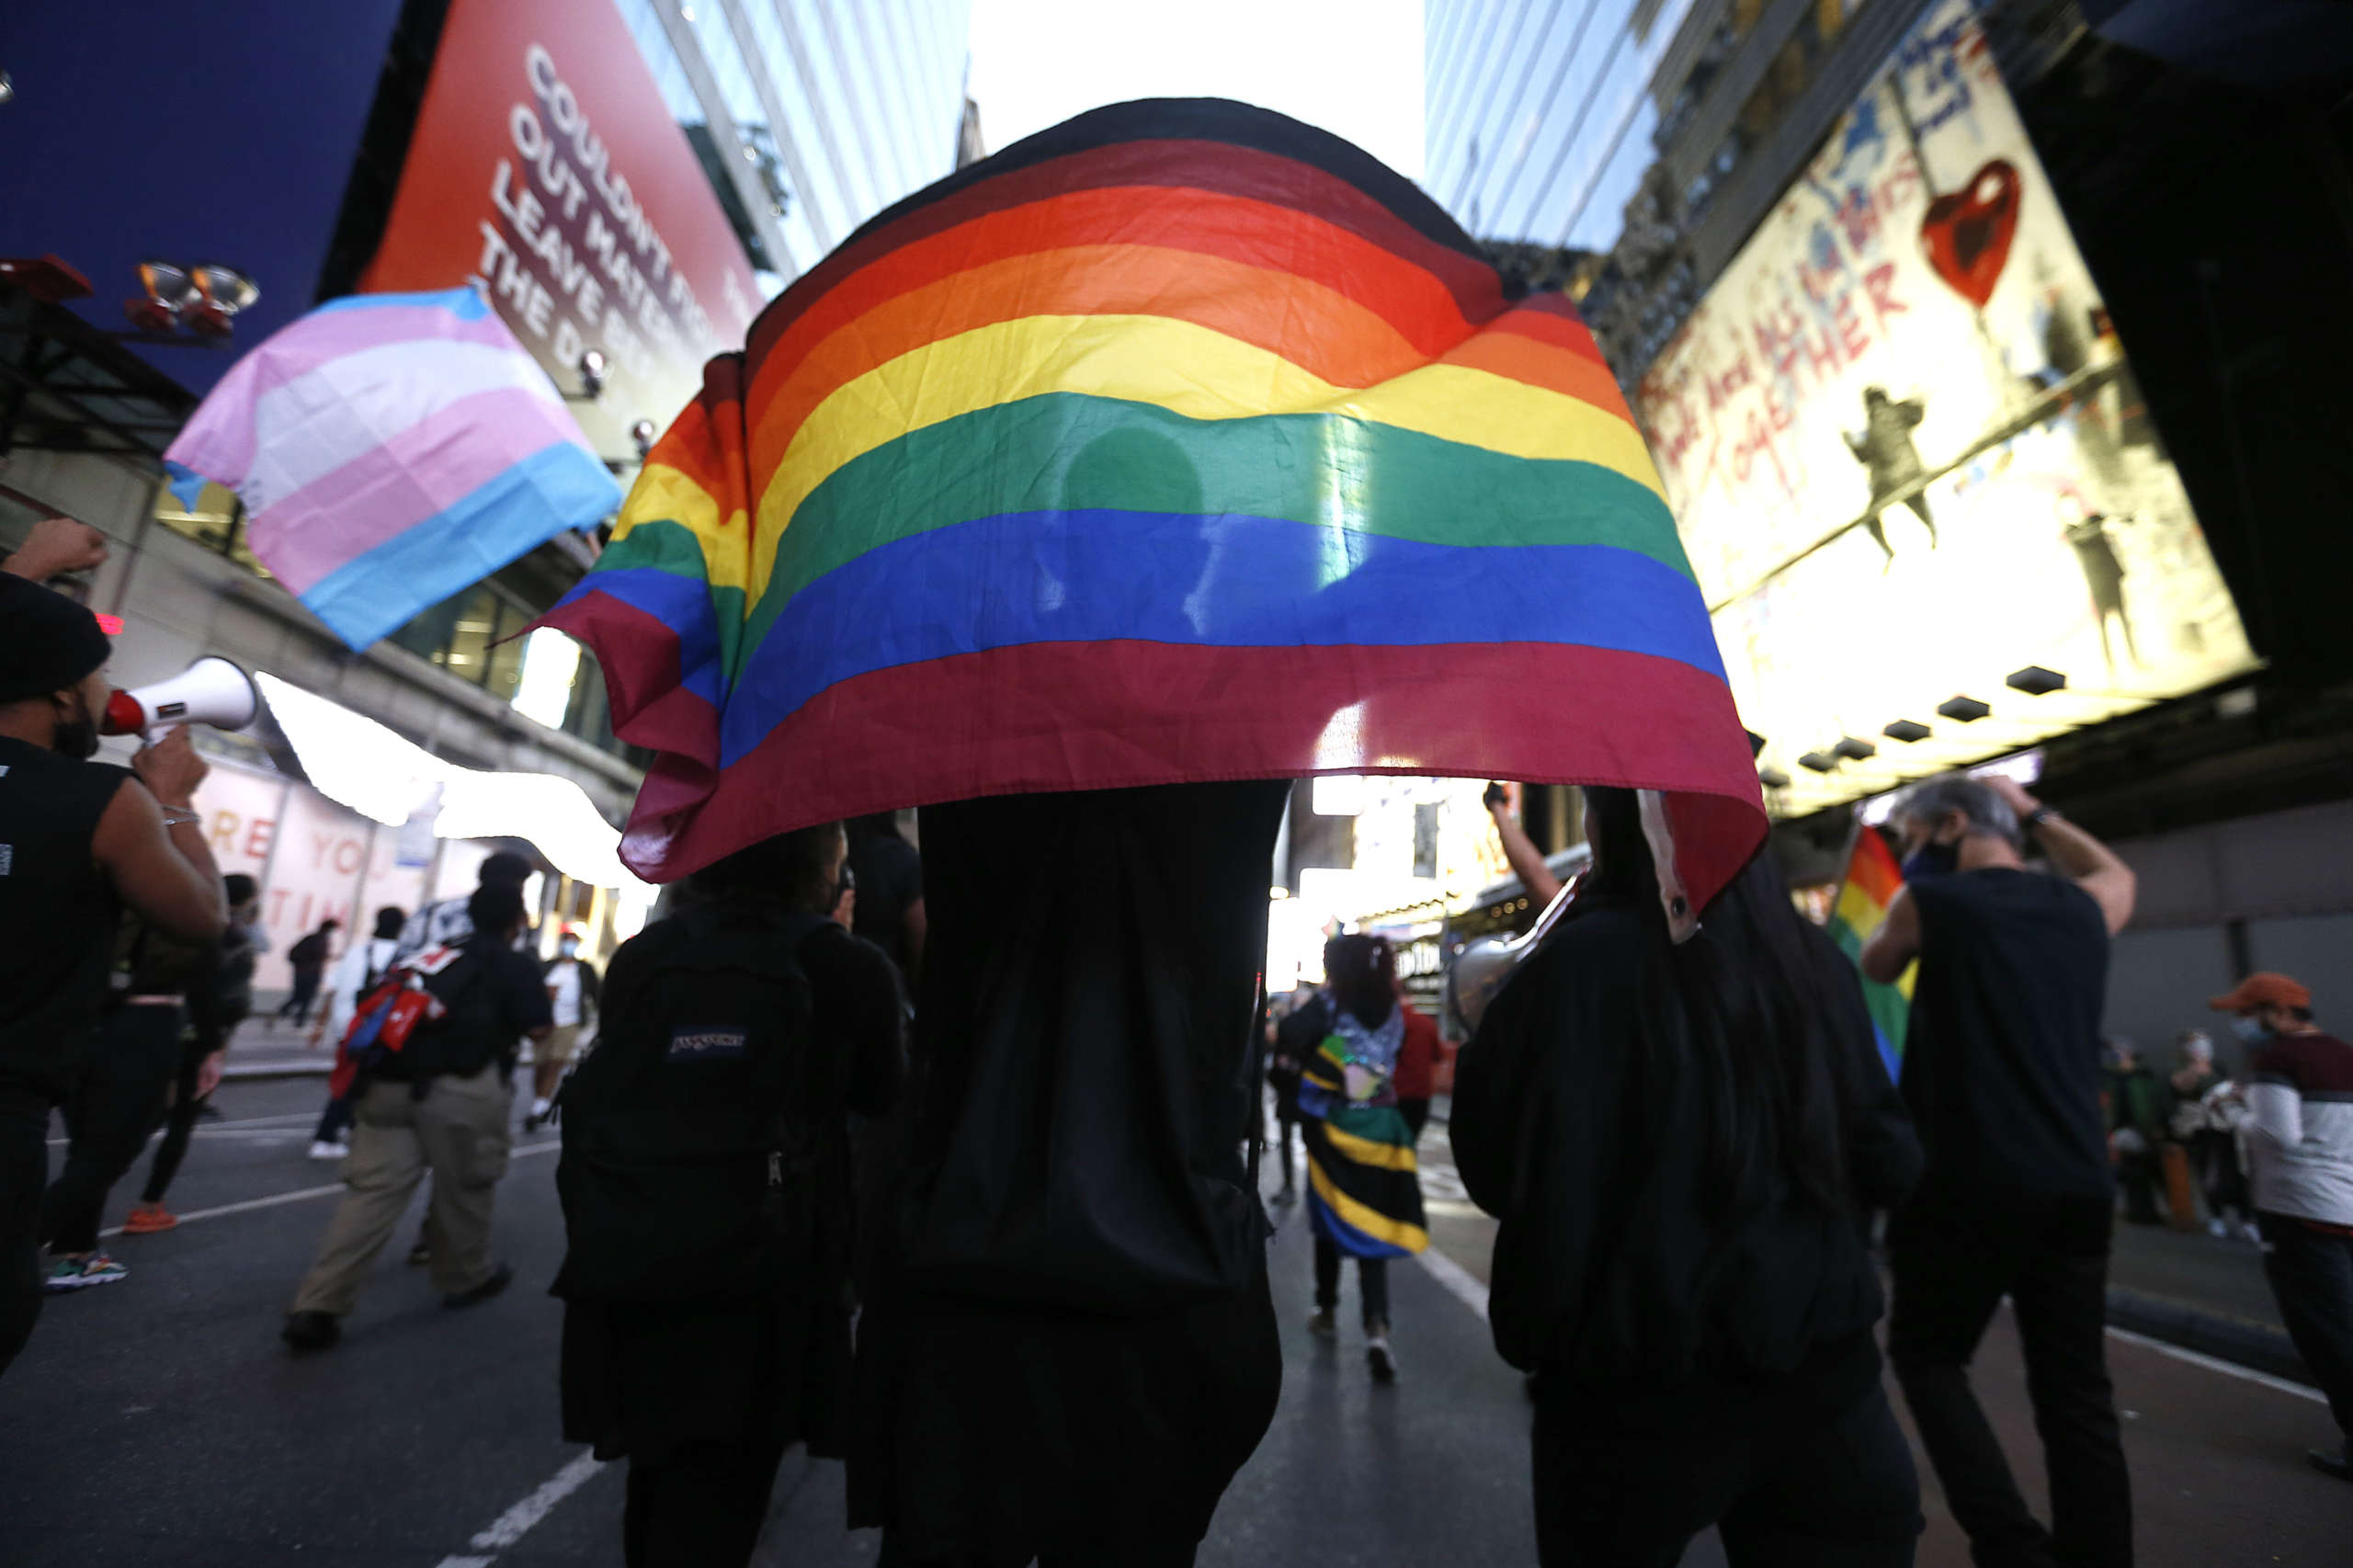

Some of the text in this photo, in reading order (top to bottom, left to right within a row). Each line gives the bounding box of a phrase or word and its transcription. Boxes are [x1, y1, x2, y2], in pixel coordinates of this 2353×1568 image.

[510, 104, 588, 219] OUT
[478, 219, 556, 338] THE
[490, 155, 605, 325] LEAVE
